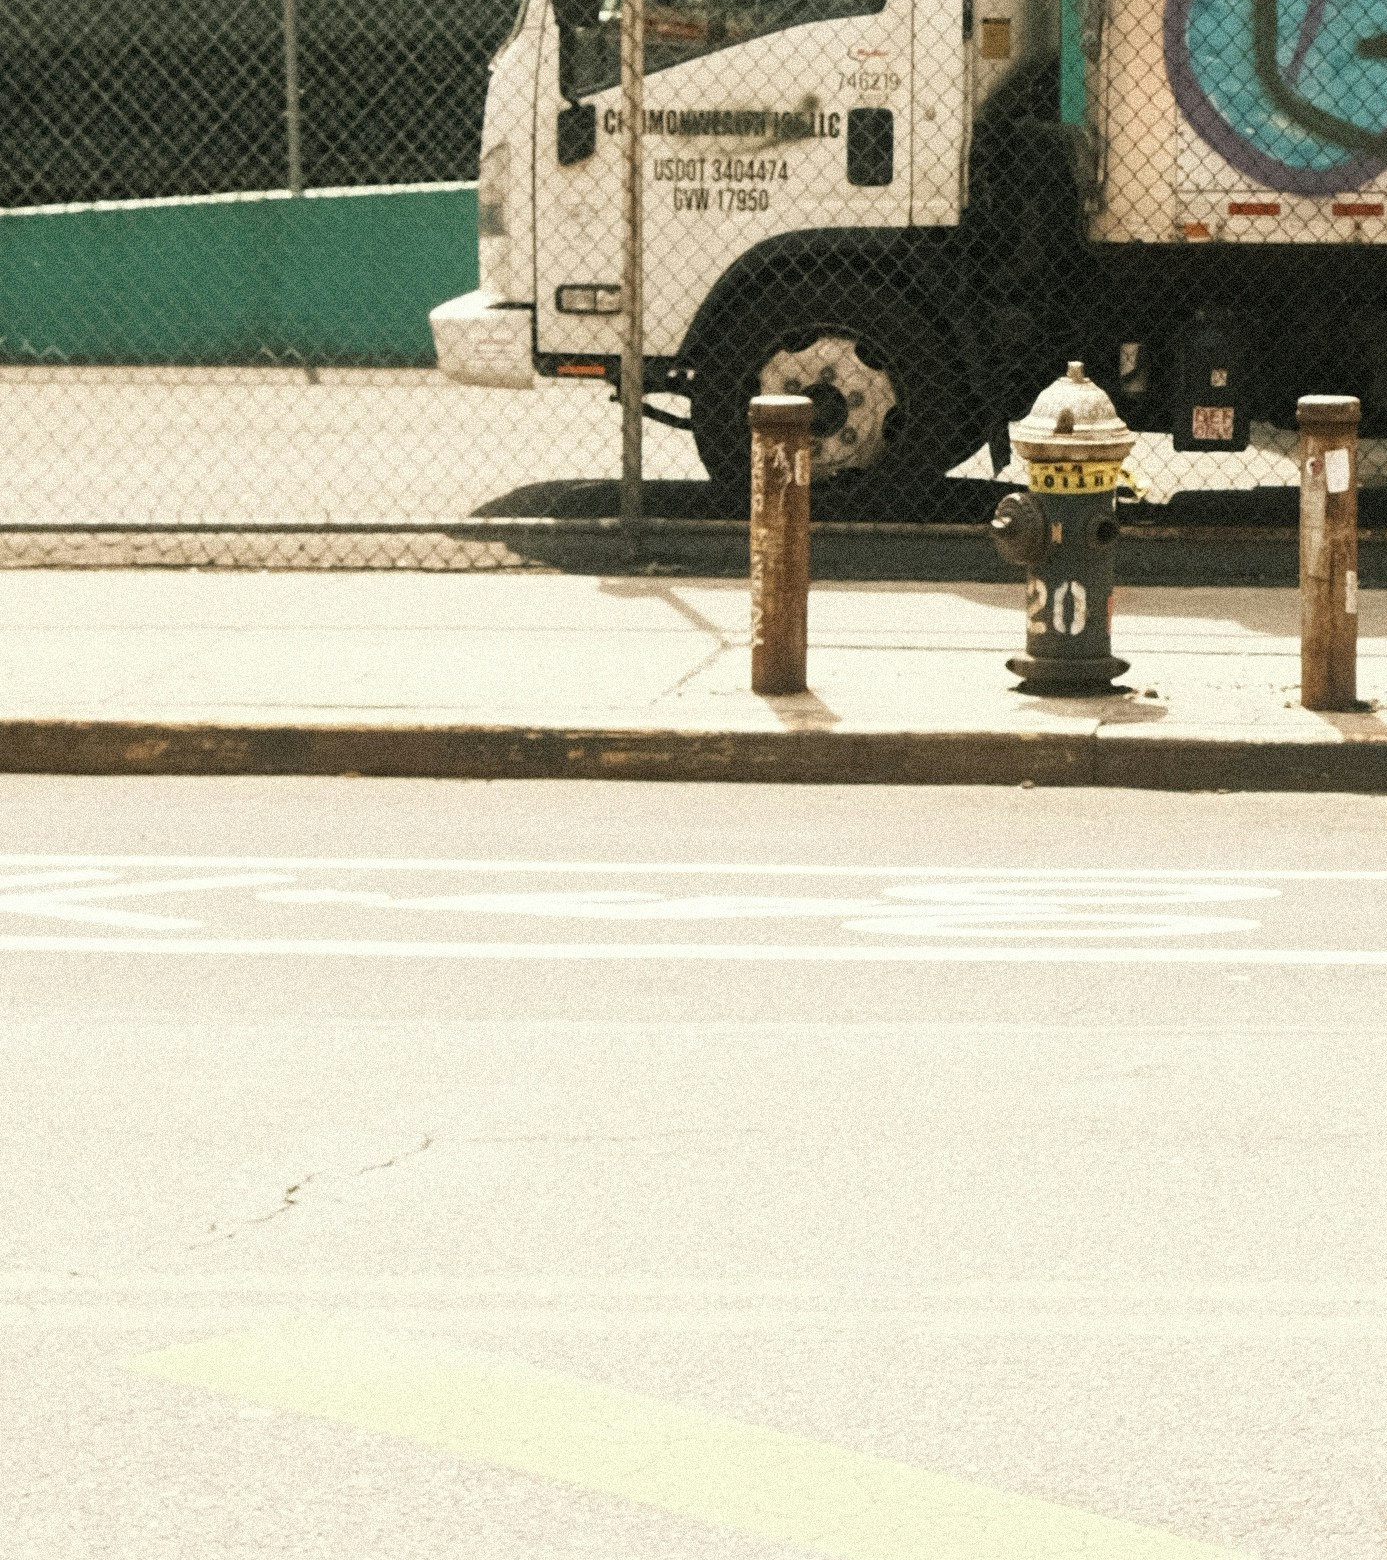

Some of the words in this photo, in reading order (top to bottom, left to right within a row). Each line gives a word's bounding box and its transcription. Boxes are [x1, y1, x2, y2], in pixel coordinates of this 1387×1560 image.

[653, 158, 706, 182] USDOT
[712, 158, 789, 182] 3404474
[673, 187, 710, 211] GVW
[718, 188, 770, 212] 17950
[1025, 578, 1087, 636] 20
